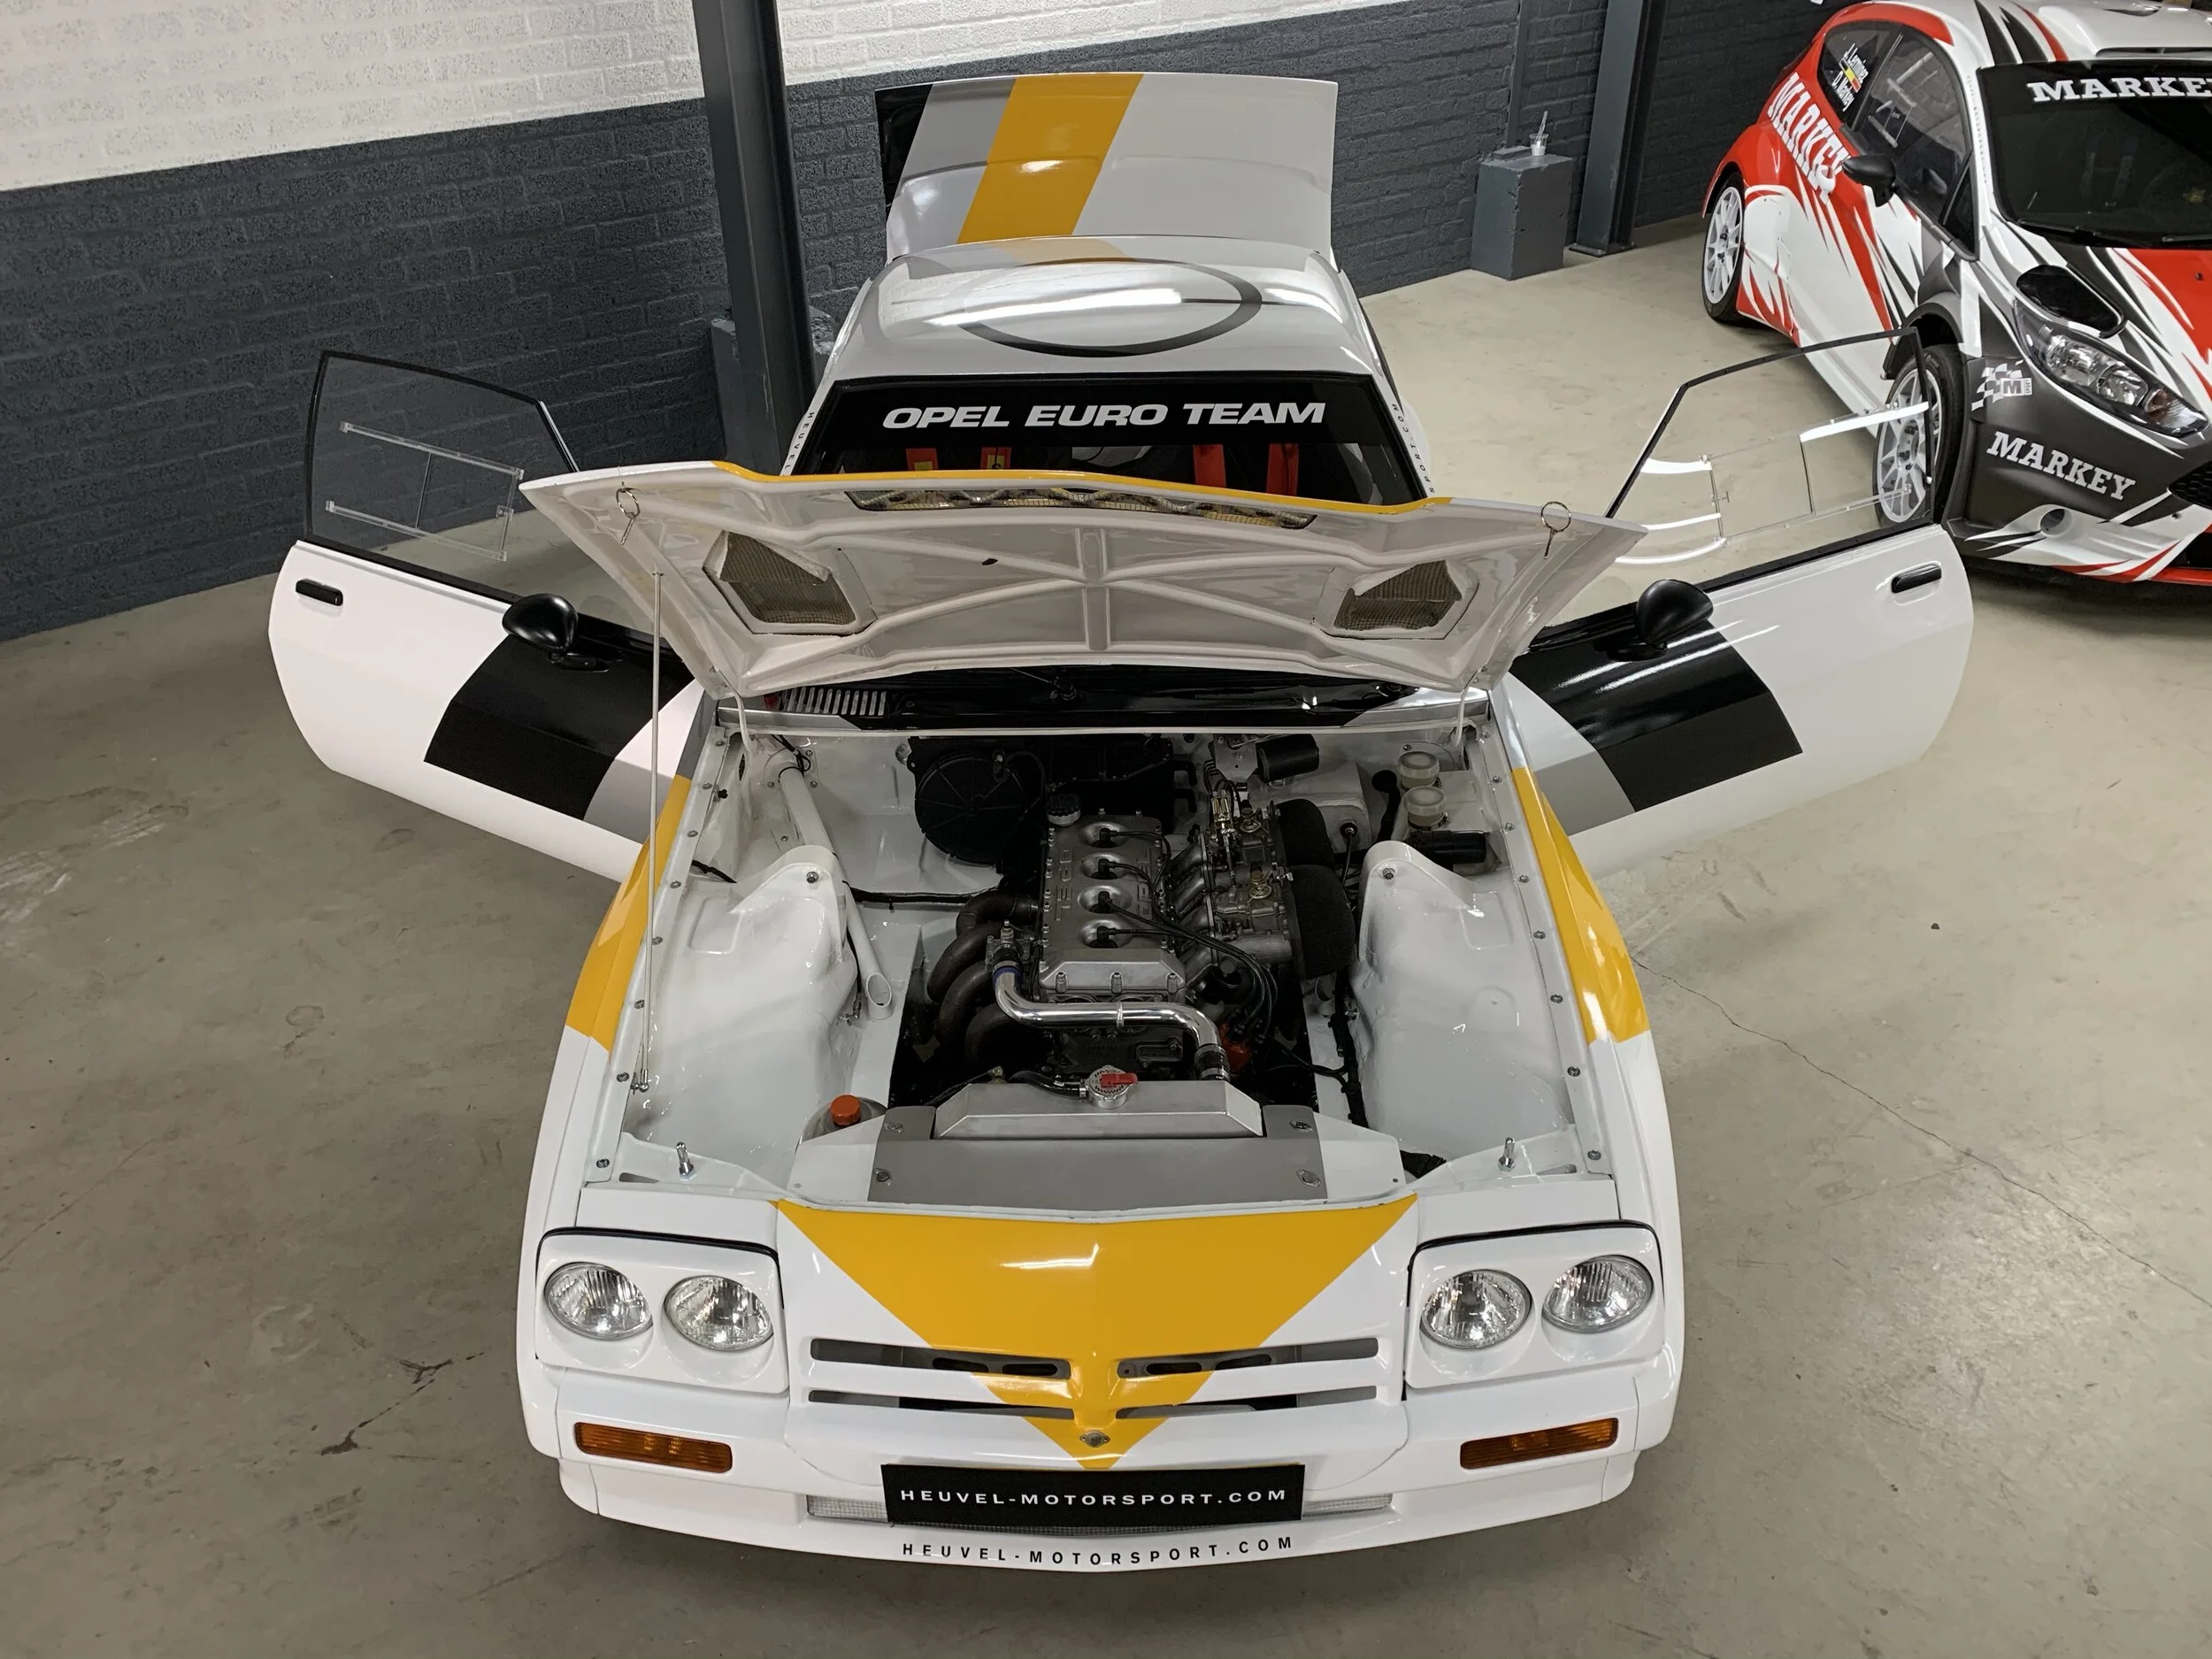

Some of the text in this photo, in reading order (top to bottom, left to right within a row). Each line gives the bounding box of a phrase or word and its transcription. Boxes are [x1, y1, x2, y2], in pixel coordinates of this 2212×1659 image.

[2026, 77, 2212, 102] MARKE
[883, 402, 1326, 429] OPEL EURO TEAM
[1986, 431, 2137, 501] MARKEY
[900, 1488, 1286, 1505] HEUVEL-MOTORSPORT.COM
[902, 1536, 1294, 1565] HEUVEL-MOTORSPORT.COM
